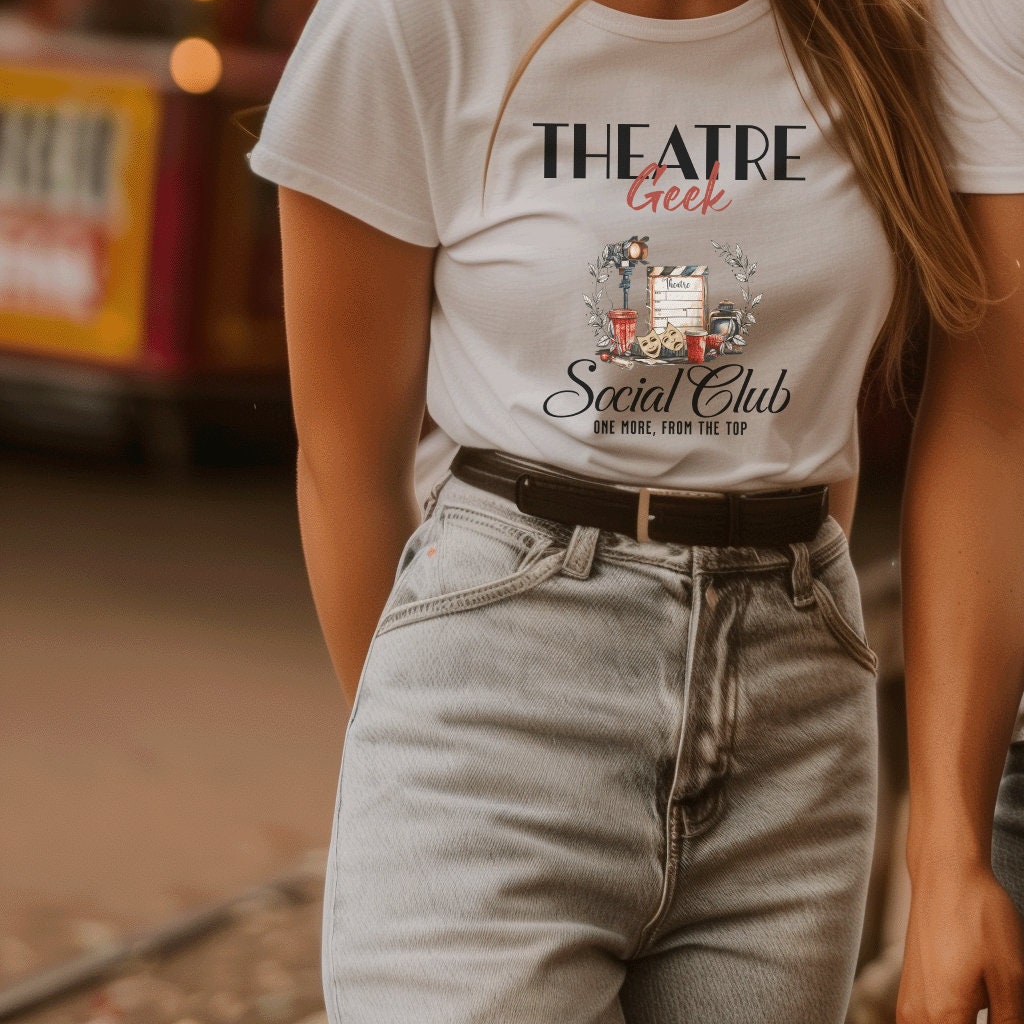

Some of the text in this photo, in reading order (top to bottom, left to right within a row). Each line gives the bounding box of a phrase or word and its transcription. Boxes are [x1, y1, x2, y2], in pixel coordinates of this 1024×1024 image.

[532, 122, 806, 181] THEATRE
[626, 160, 732, 215] Geek
[543, 358, 791, 418] Social Club
[593, 420, 748, 437] ONE MORE, FROM THE TOP
